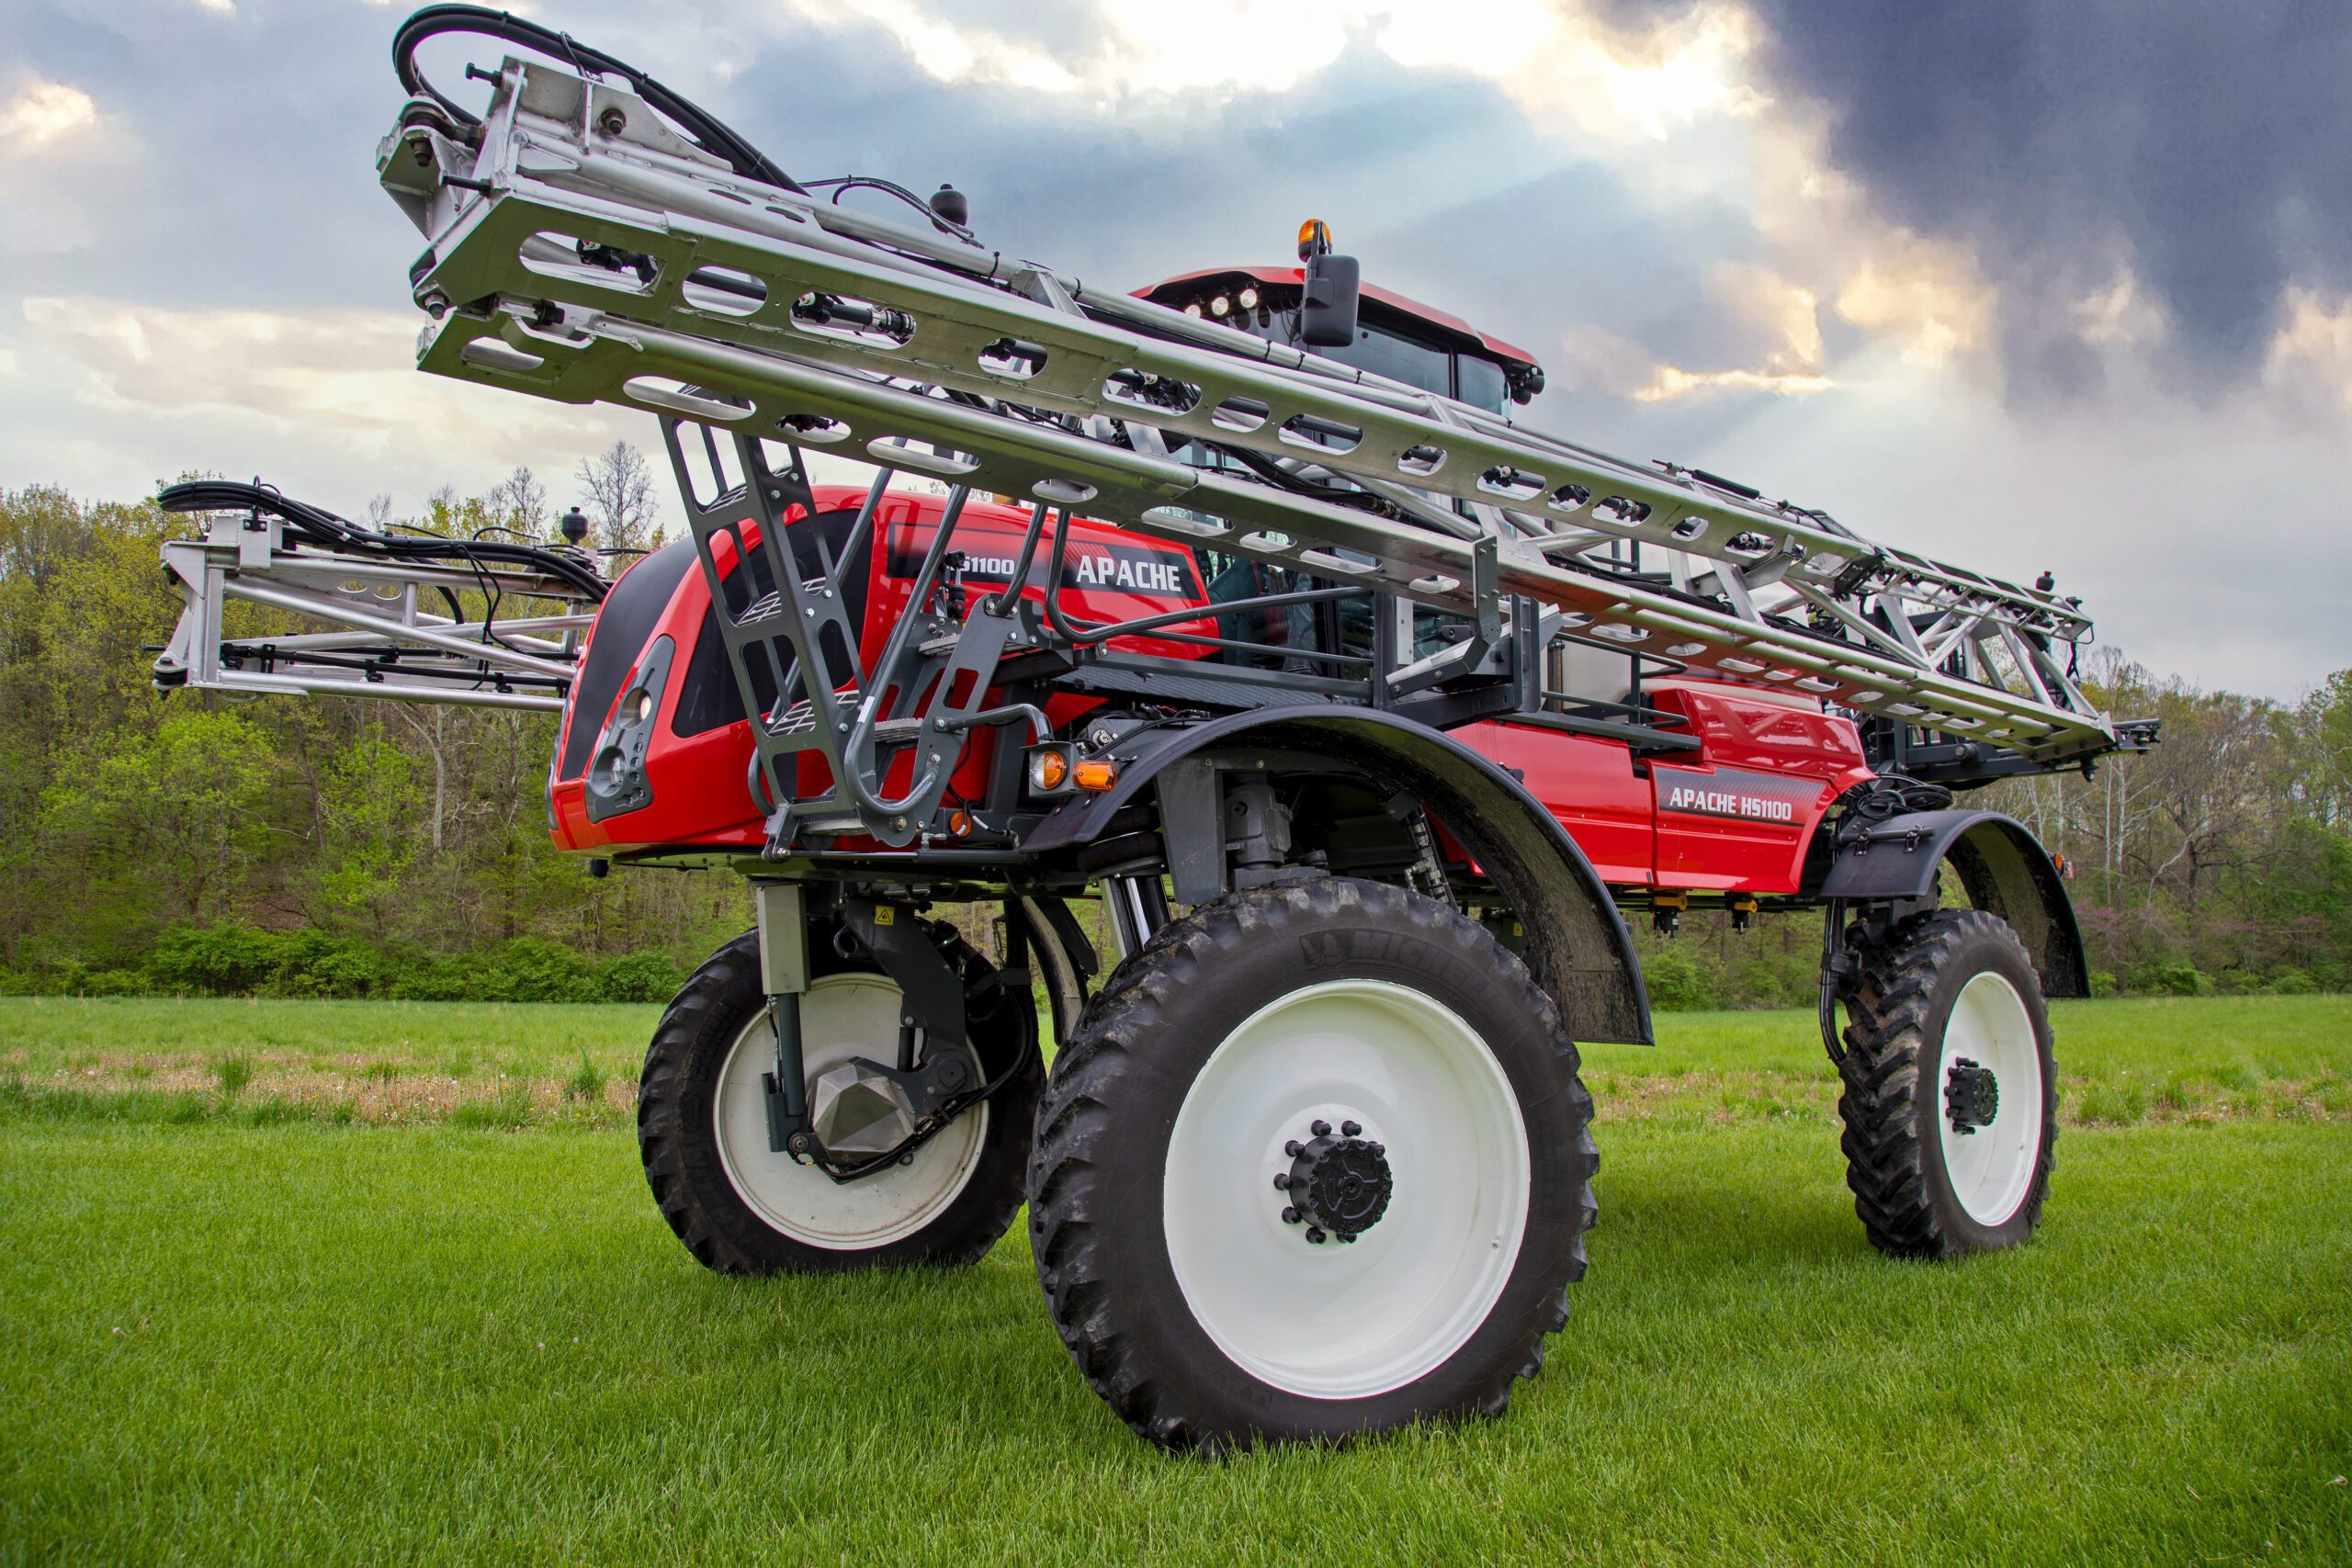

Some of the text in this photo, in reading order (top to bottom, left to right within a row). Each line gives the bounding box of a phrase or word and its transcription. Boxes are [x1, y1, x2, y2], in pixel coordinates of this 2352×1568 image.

[951, 556, 1014, 575] S1100
[1076, 555, 1182, 592] APACHE
[1669, 787, 1792, 820] APACHE HS1100
